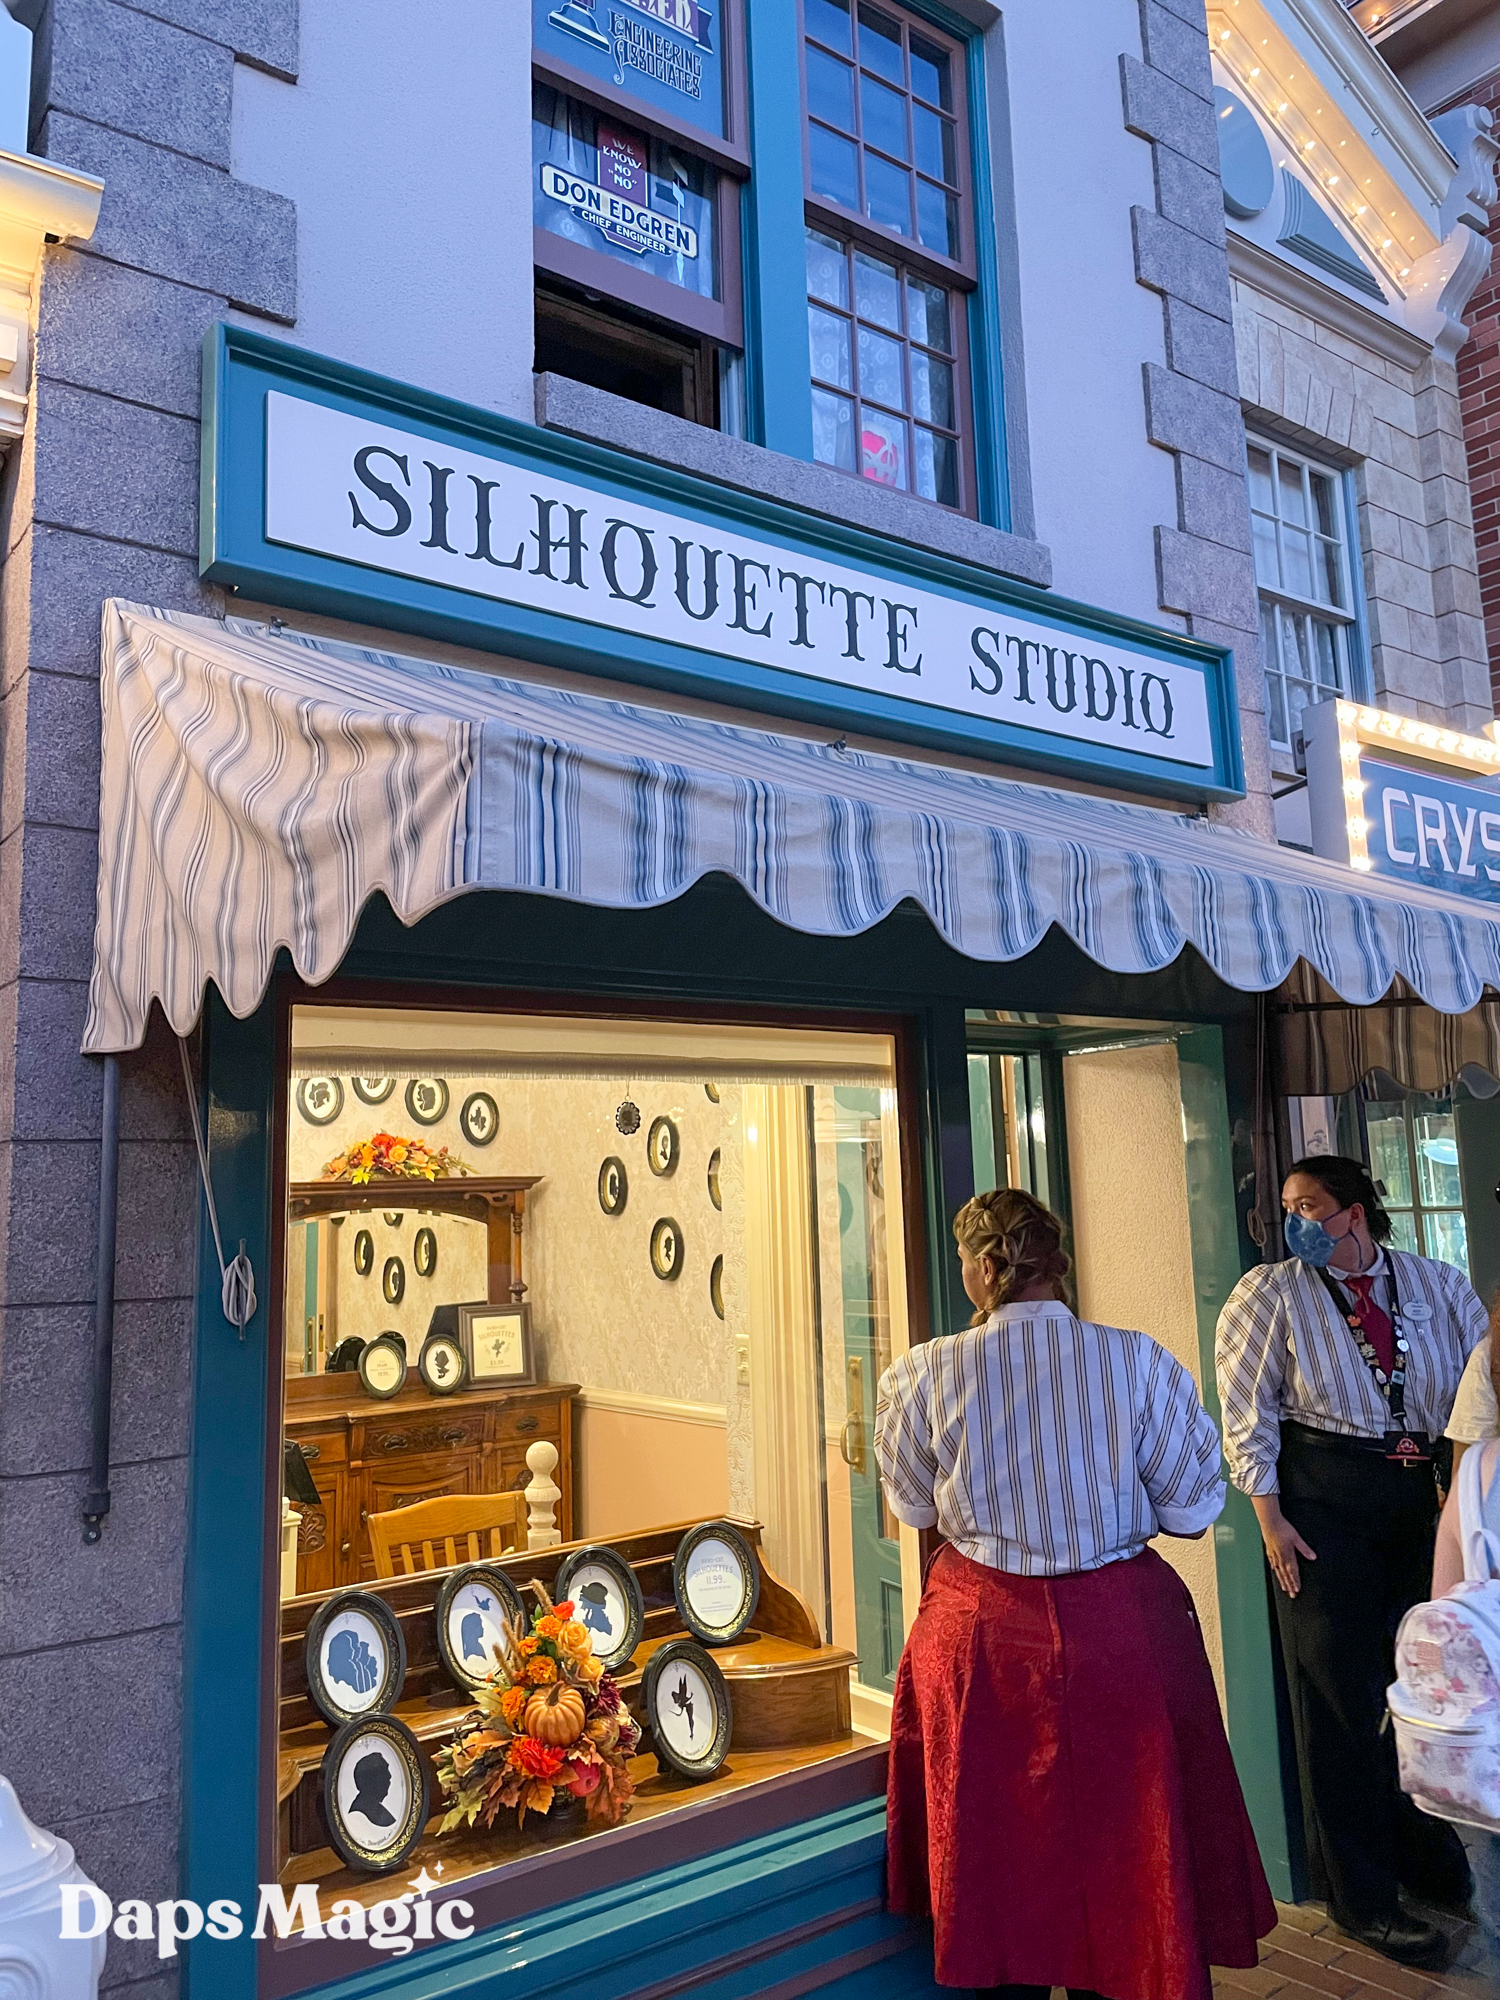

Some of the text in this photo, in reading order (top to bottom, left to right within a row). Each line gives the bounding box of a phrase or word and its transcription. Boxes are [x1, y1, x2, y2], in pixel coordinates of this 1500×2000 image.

[608, 9, 702, 78] ENGINEERING
[613, 38, 701, 100] ASSOCIATES
[603, 145, 641, 169] KNOW
[612, 138, 635, 155] WE
[614, 162, 632, 177] NO
[553, 172, 690, 252] DON EDGREN
[581, 209, 667, 254] CHIEF ENGINEER
[348, 445, 1176, 740] SILHOUETTE STUDIO
[692, 1564, 734, 1577] SILHOUETTES
